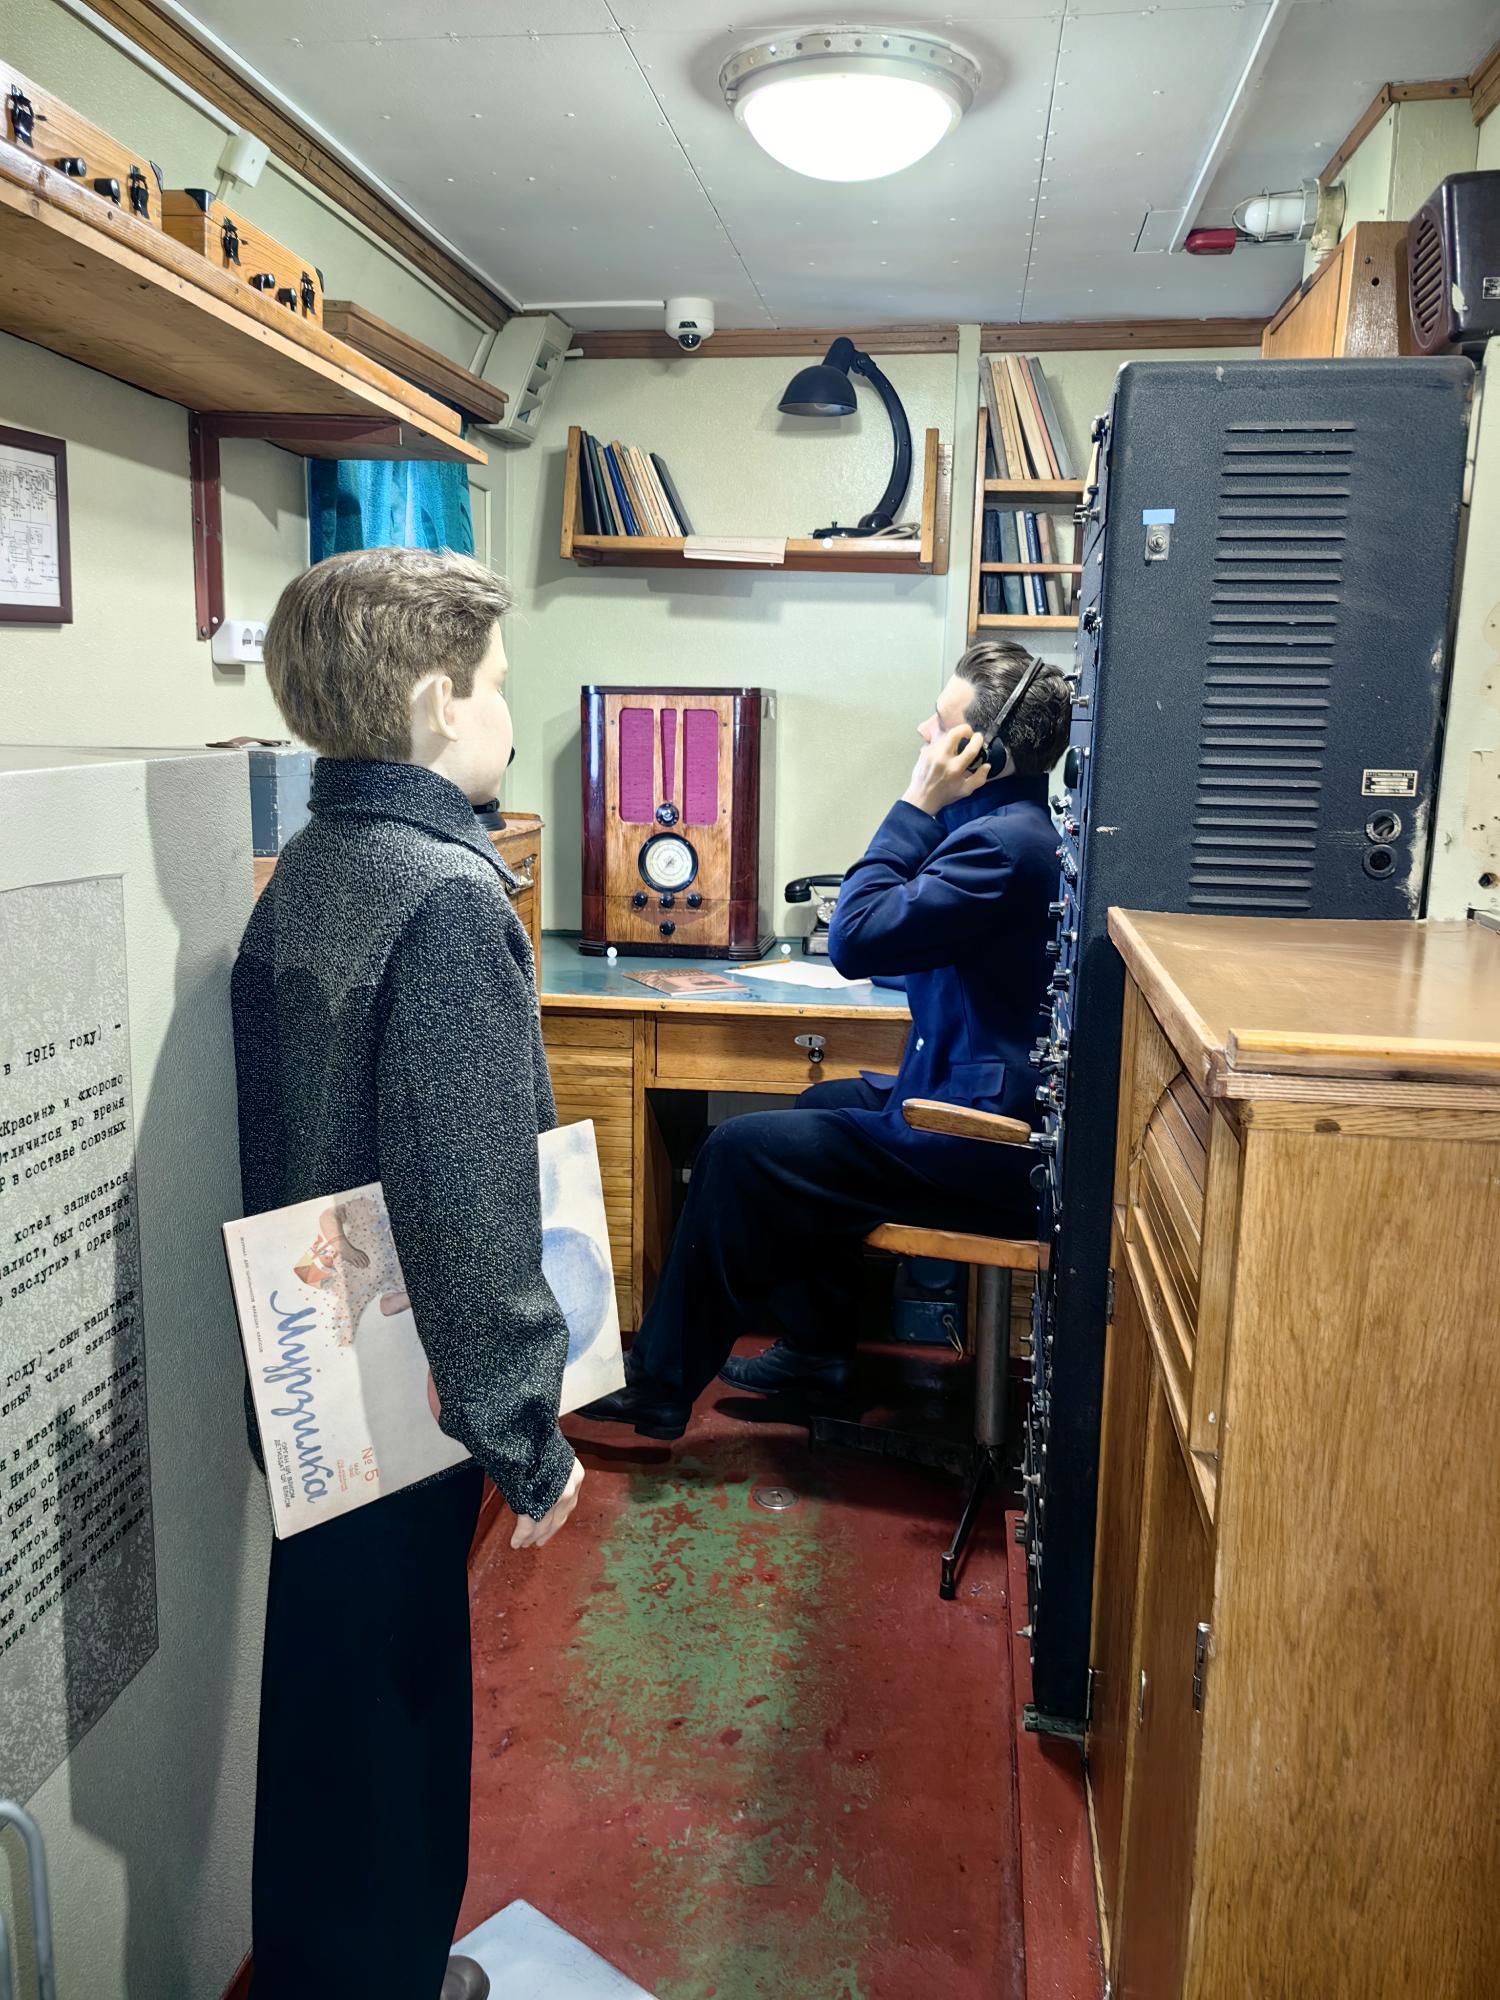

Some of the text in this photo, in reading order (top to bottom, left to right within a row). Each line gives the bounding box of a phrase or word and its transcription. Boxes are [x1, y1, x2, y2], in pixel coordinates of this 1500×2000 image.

[3, 1063, 11, 1076] в
[69, 1023, 102, 1050] году)
[63, 1097, 70, 1109] и
[71, 1116, 85, 1132] во
[92, 1096, 125, 1121] время
[12, 1173, 20, 1186] в
[25, 1145, 76, 1179] составе
[81, 1120, 127, 1151] союзных
[0, 1194, 130, 1280] алист, был оставлен
[13, 1171, 129, 1245] хотел записаться
[11, 1216, 131, 1299] заслуги» и орденом
[6, 1349, 42, 1388] году)
[59, 1327, 81, 1349] сын
[83, 1289, 135, 1333] капитана
[45, 1356, 73, 1383] член
[13, 1448, 20, 1462] в
[26, 1403, 77, 1451] штатную
[81, 1355, 138, 1408] навигацию
[262, 1289, 334, 1504] Мурзилка
[7, 1486, 37, 1518] было
[41, 1438, 95, 1489] оставить
[10, 1458, 40, 1490] Нина
[47, 1398, 114, 1458] Сафроновна
[11, 1513, 34, 1543] для
[98, 1418, 140, 1466] который
[364, 1467, 379, 1482] 5
[25, 1551, 73, 1606] подавал
[81, 1501, 127, 1552] кассеты
[131, 1485, 144, 1503] со
[31, 1527, 73, 1574] прошёл
[81, 1465, 142, 1531] ускоренные
[31, 1562, 87, 1623] самолёты
[90, 1506, 145, 1567] атаковали
